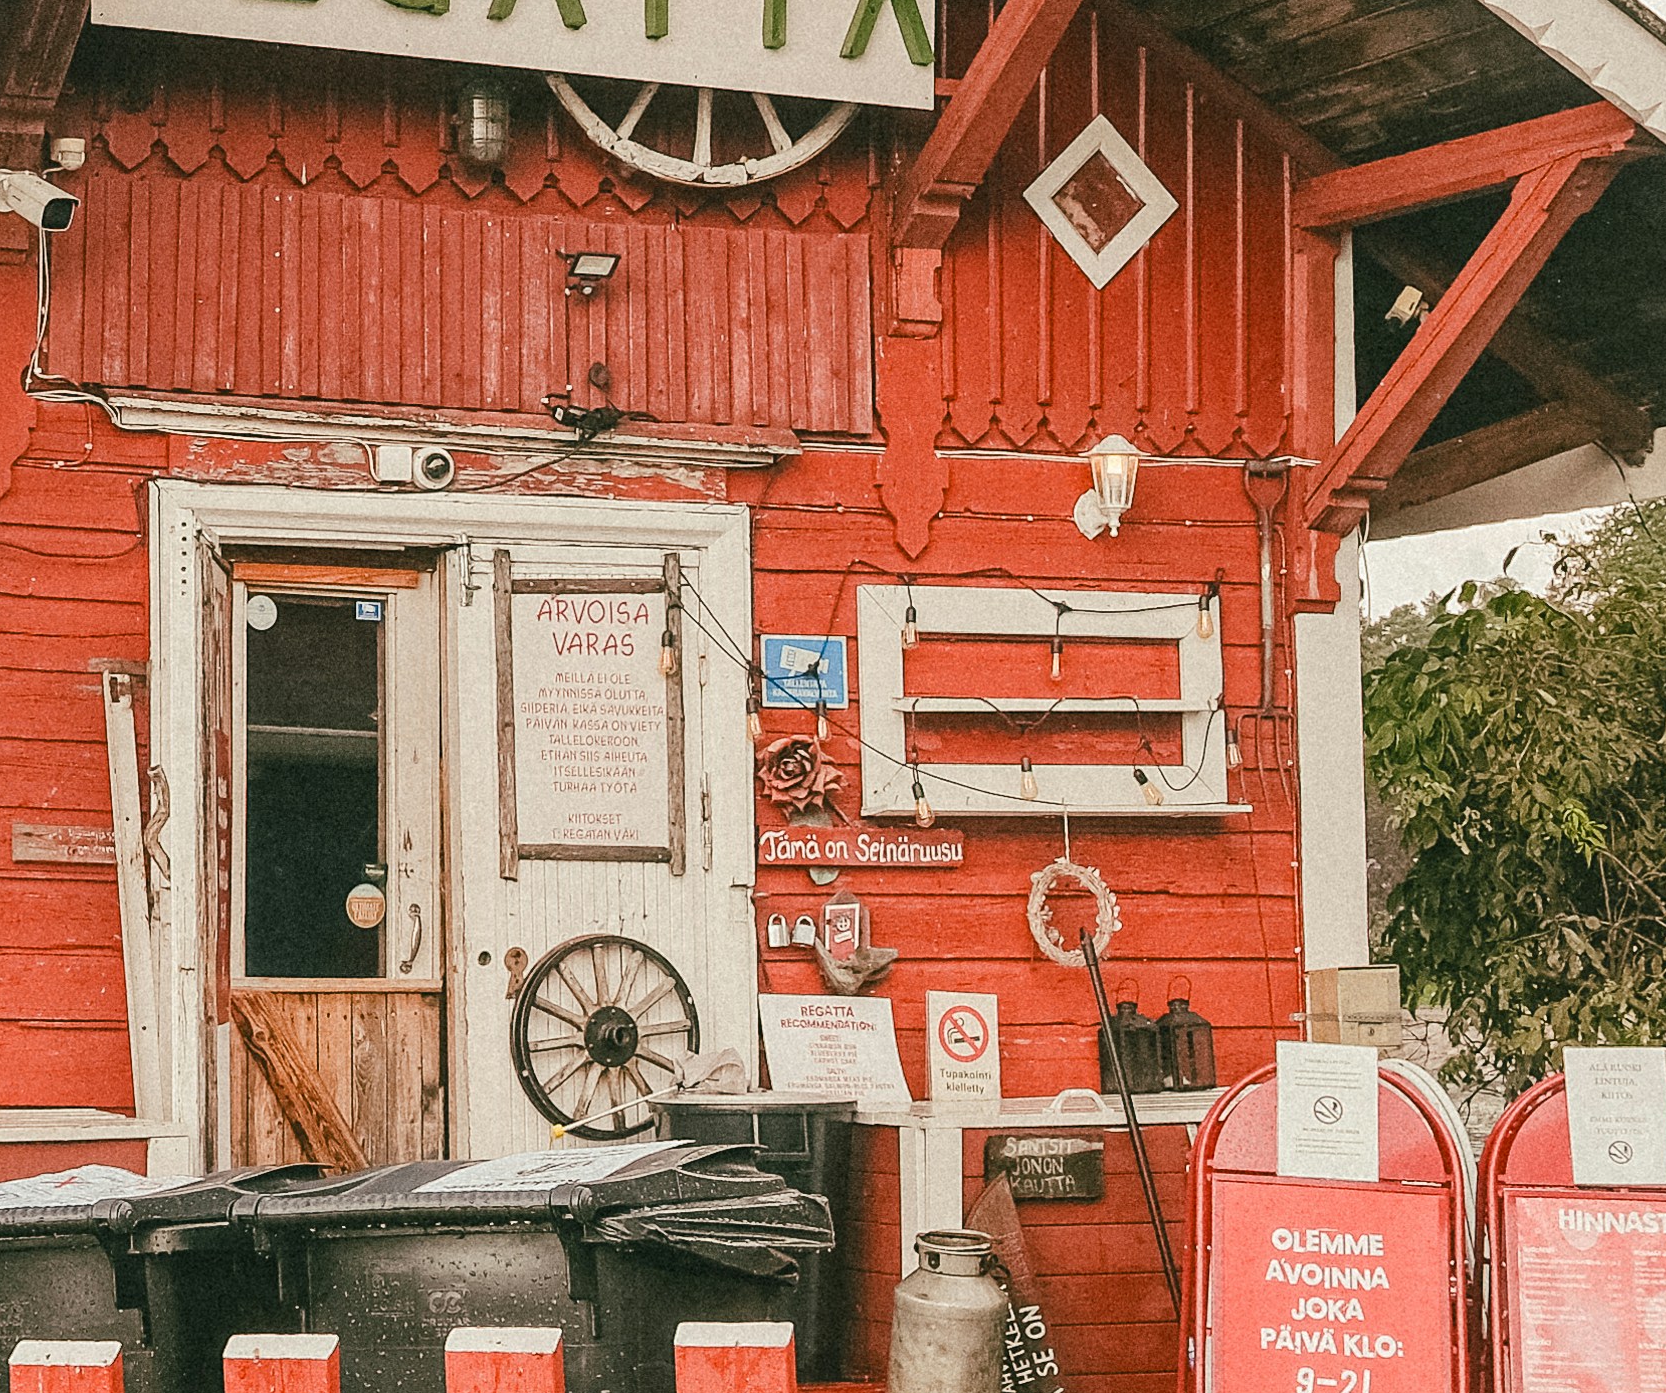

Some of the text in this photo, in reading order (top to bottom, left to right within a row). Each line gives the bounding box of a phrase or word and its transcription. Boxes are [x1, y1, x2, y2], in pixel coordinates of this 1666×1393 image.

[537, 600, 649, 624] ARVOISA
[553, 631, 634, 656] VARAS
[610, 673, 631, 684] OLE
[573, 719, 608, 731] KASSA
[611, 720, 627, 731] ON
[629, 721, 662, 731] VIETY
[579, 751, 599, 762] SIIS
[552, 781, 597, 793] TURHAA
[568, 813, 622, 825] KIITOKSET
[563, 829, 610, 840] REGATAN
[759, 830, 964, 863] Tämä on Seinäruusu
[800, 1005, 854, 1017] REGATTA
[940, 1068, 991, 1080] Tupakointi
[946, 1082, 984, 1094] kielletty
[1012, 1157, 1064, 1176] JONON
[1010, 1175, 1076, 1193] KAUTTA
[1271, 1228, 1384, 1256] OLEMME
[1265, 1258, 1389, 1291] AVOINNA
[1291, 1297, 1365, 1323] JOKA
[1019, 1305, 1046, 1340] ON
[1260, 1324, 1404, 1358] PÄIVÄ KLO:
[1032, 1348, 1059, 1377] SE
